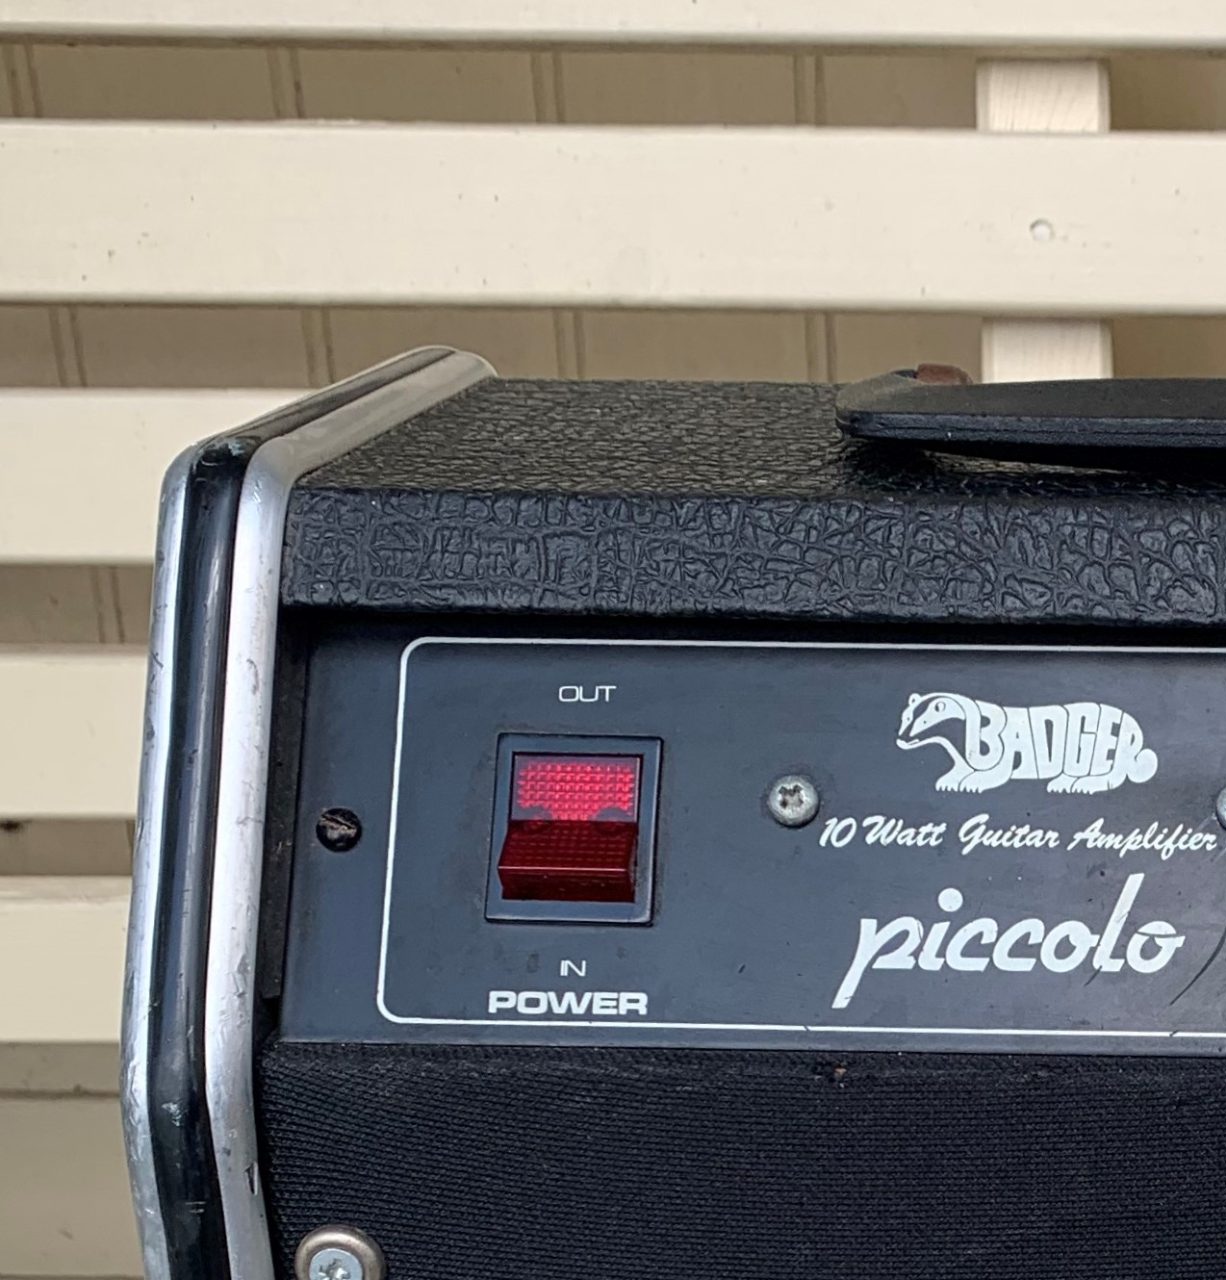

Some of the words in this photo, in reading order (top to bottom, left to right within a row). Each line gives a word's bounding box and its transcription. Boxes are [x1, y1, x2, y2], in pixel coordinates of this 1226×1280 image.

[558, 685, 617, 703] OUT
[963, 699, 1158, 787] BADGER
[818, 817, 858, 848] 10
[862, 816, 945, 846] Watt
[958, 813, 1060, 855] Guitar
[1066, 817, 1218, 860] Amplifier
[831, 872, 1186, 1009] piccolo
[560, 959, 587, 977] IN
[488, 991, 649, 1016] POWER
